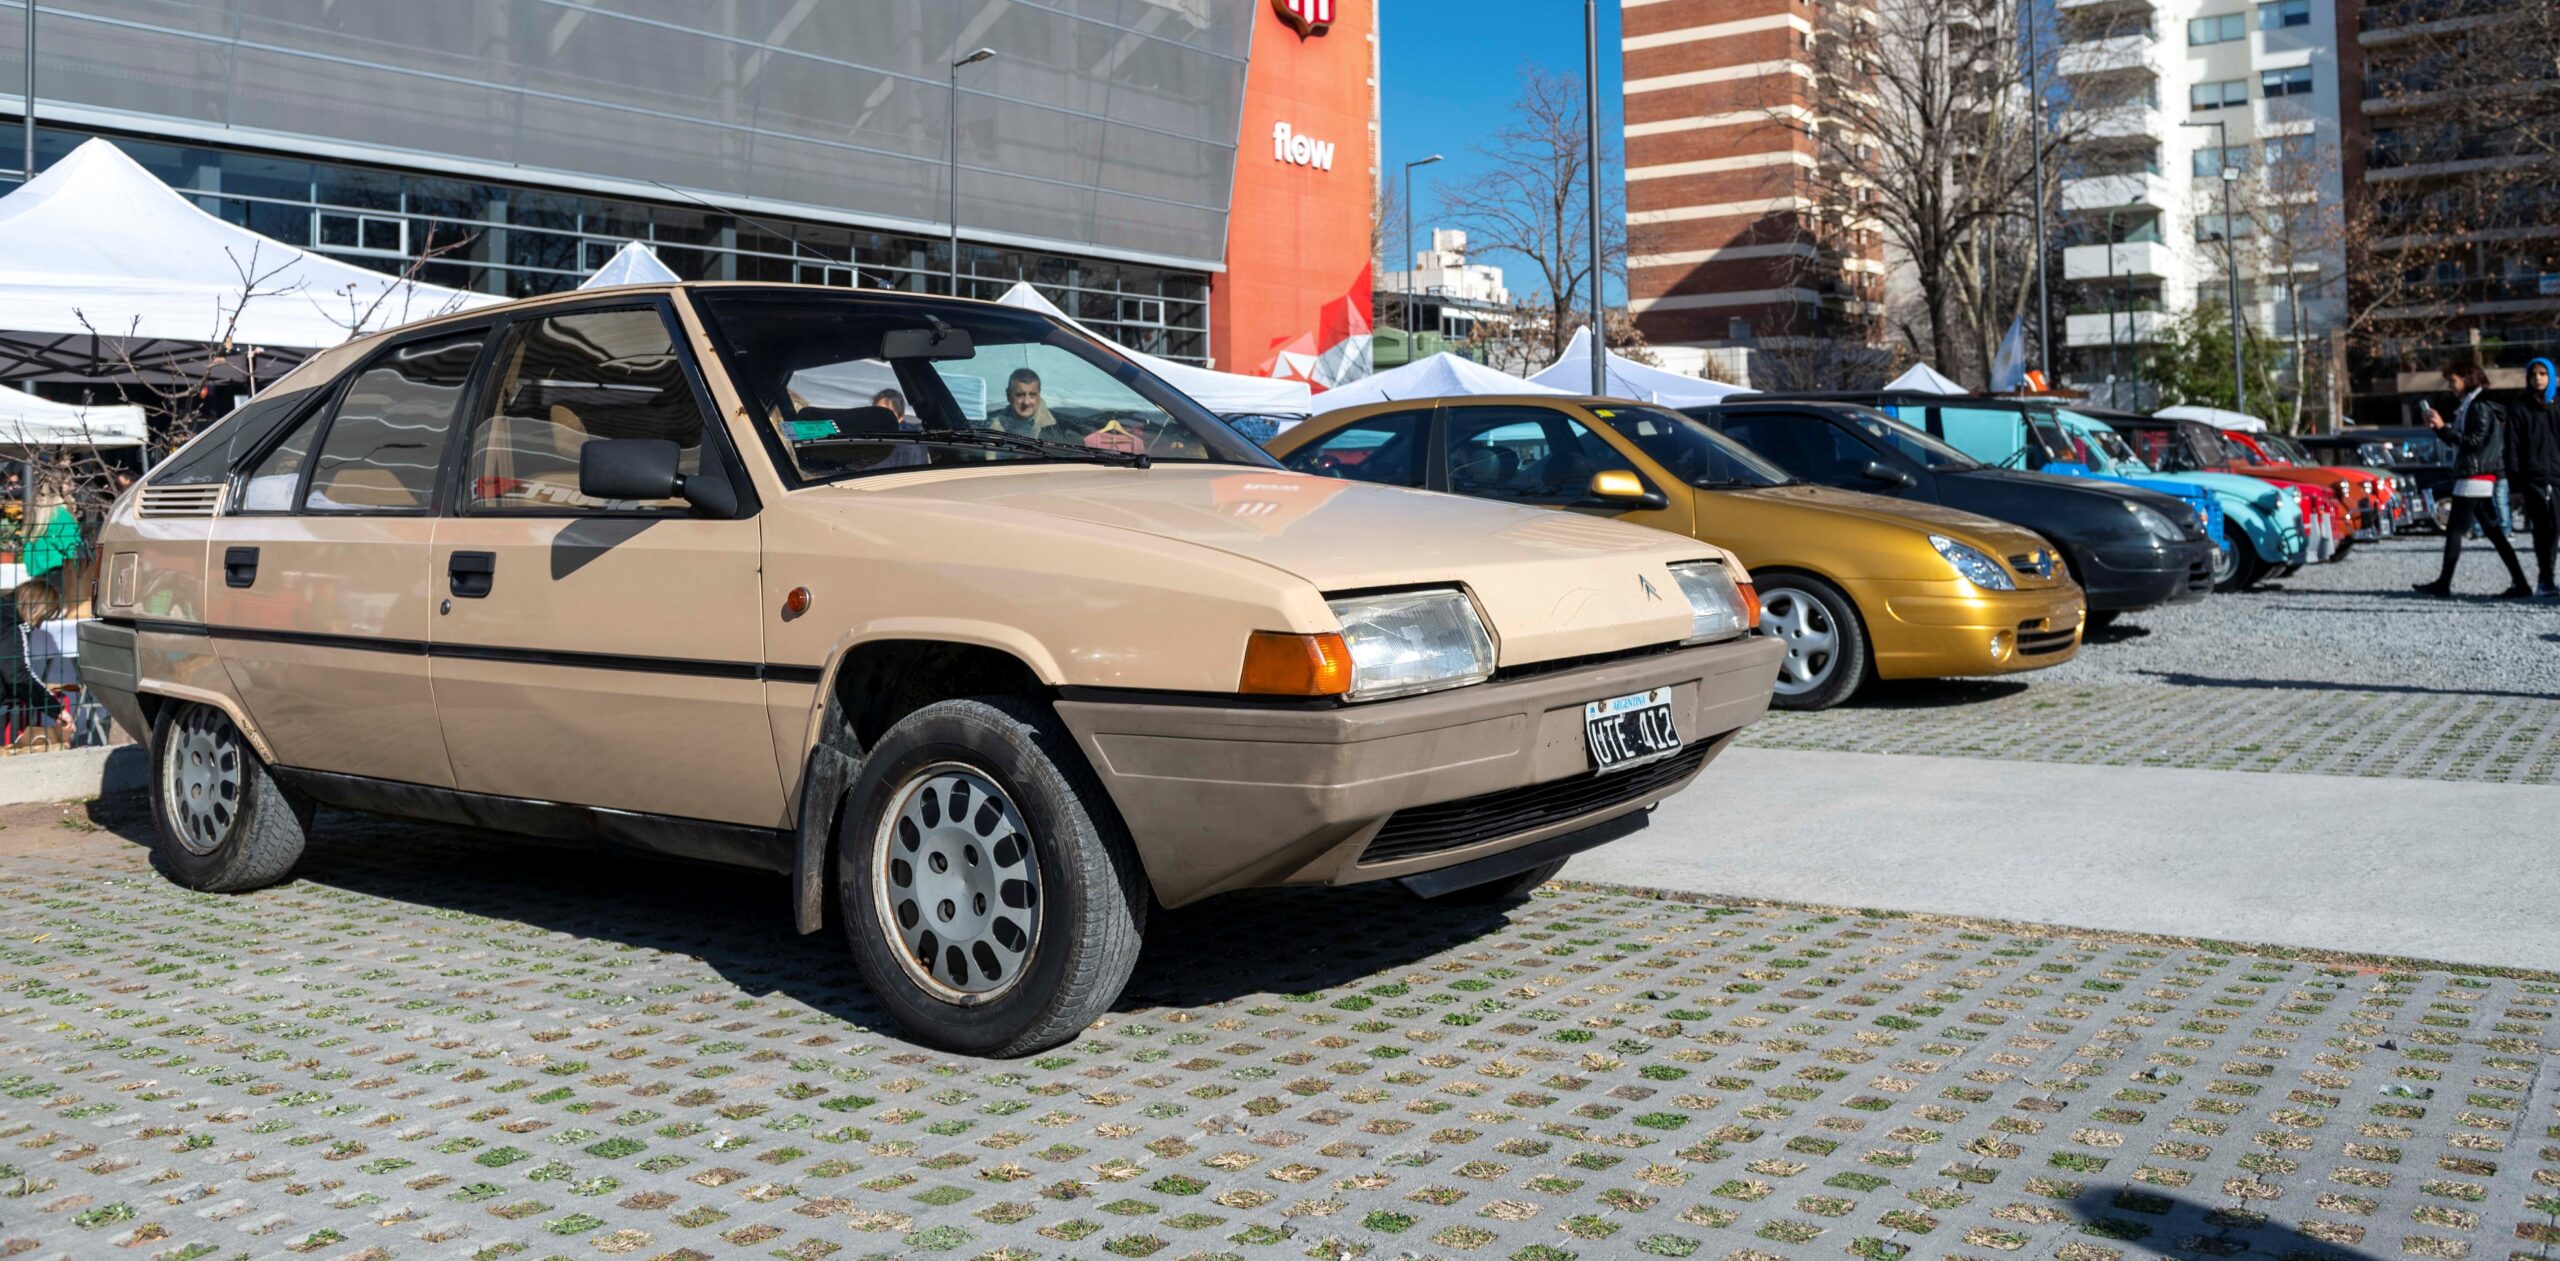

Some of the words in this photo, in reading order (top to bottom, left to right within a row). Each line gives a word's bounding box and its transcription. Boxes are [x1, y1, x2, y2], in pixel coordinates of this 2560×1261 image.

[1273, 121, 1335, 171] flow
[1612, 695, 1646, 711] ARGENTINA
[1591, 714, 1636, 764] UTE
[1639, 707, 1679, 751] 412
